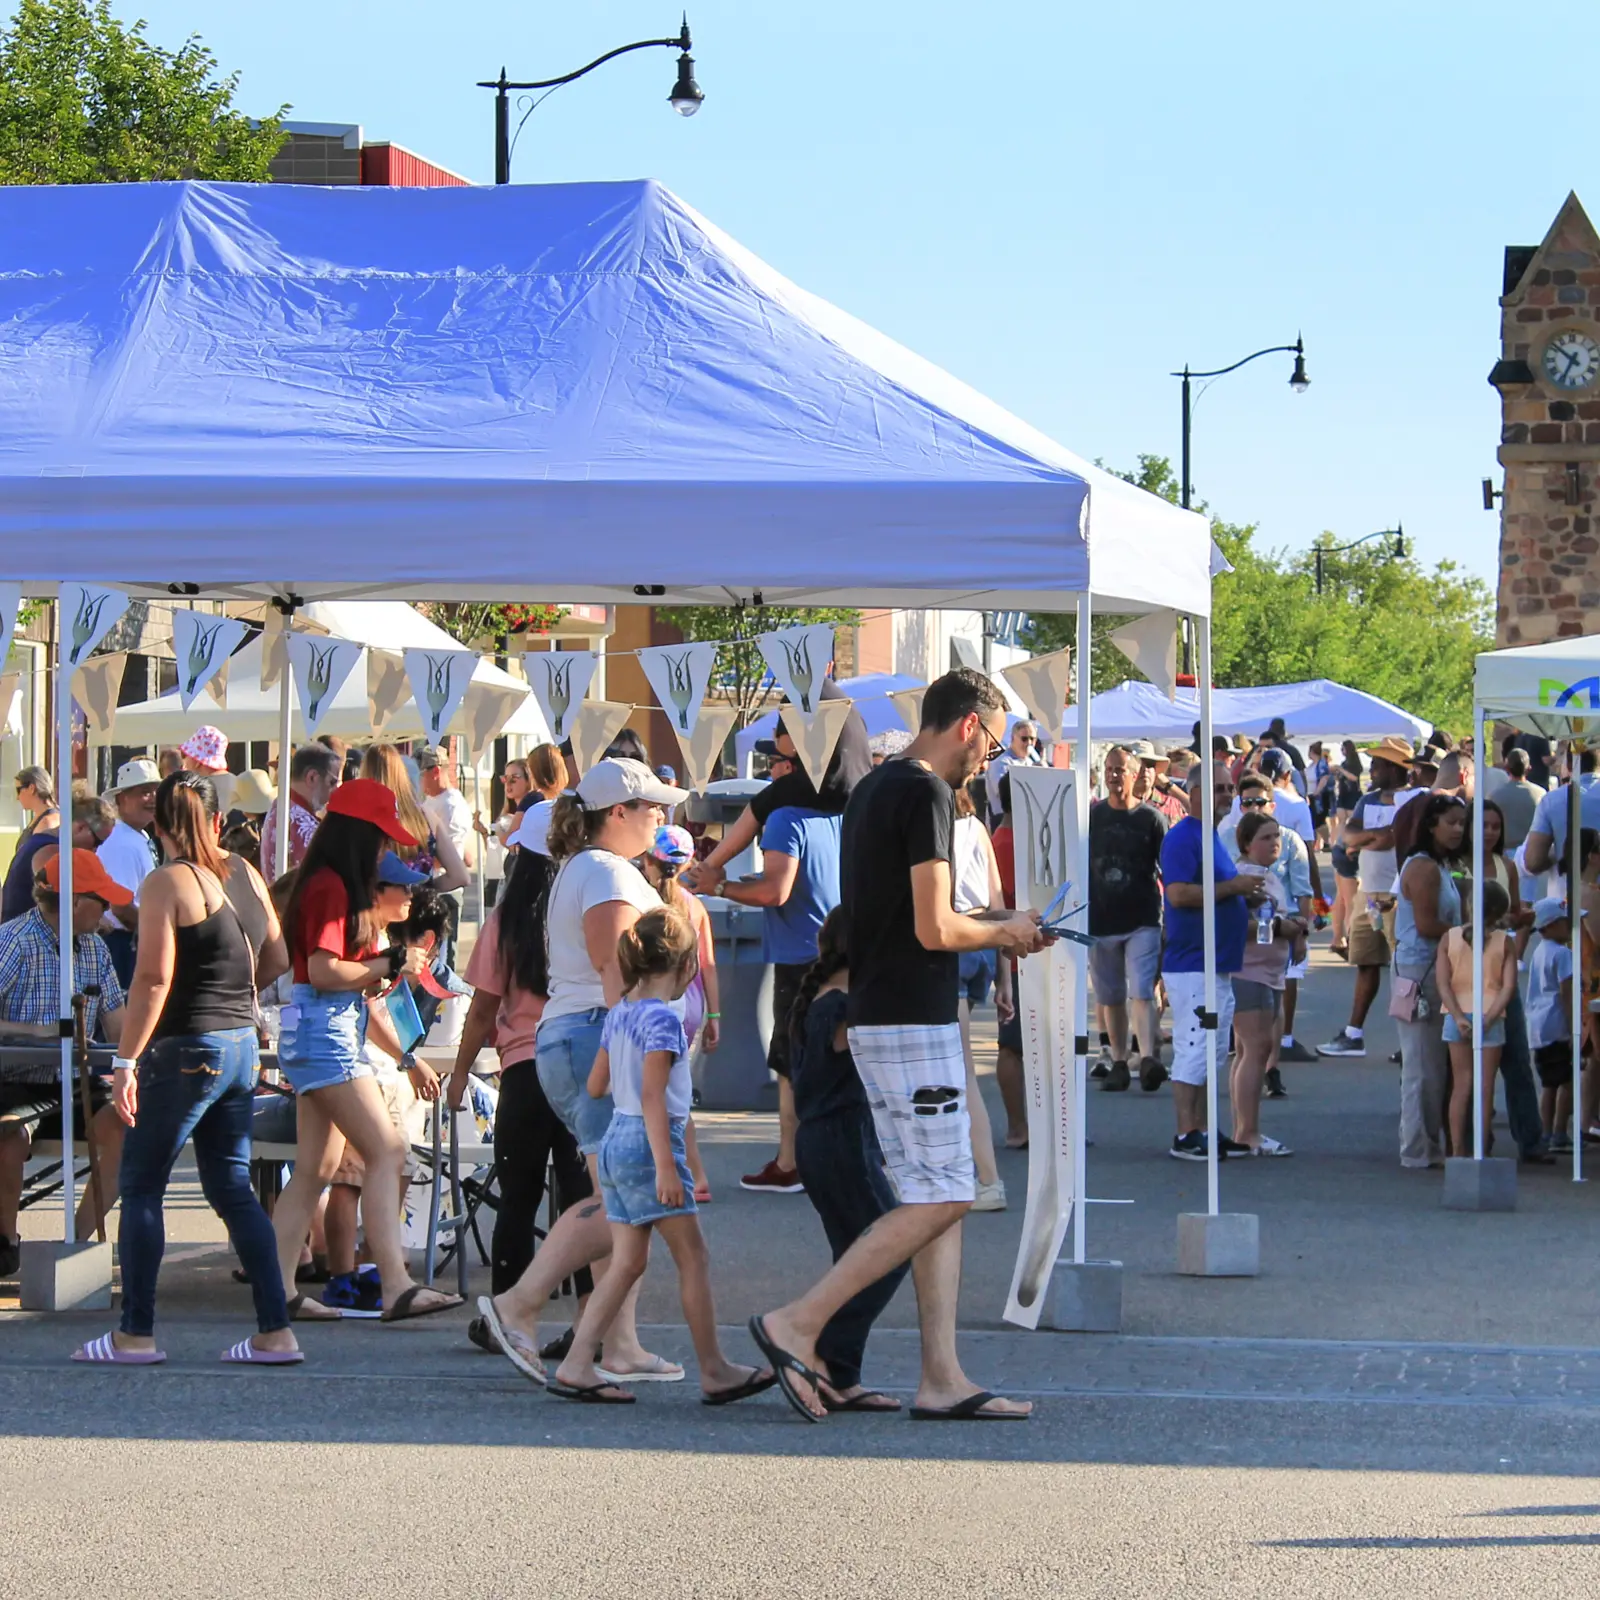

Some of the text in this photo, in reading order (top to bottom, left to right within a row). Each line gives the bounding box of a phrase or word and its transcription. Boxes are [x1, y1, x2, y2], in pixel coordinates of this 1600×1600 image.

[1028, 1006, 1040, 1047] JULY
[1058, 963, 1069, 1160] TASTE OF WAINWRIGHT
[1033, 1074, 1042, 1108] 2022
